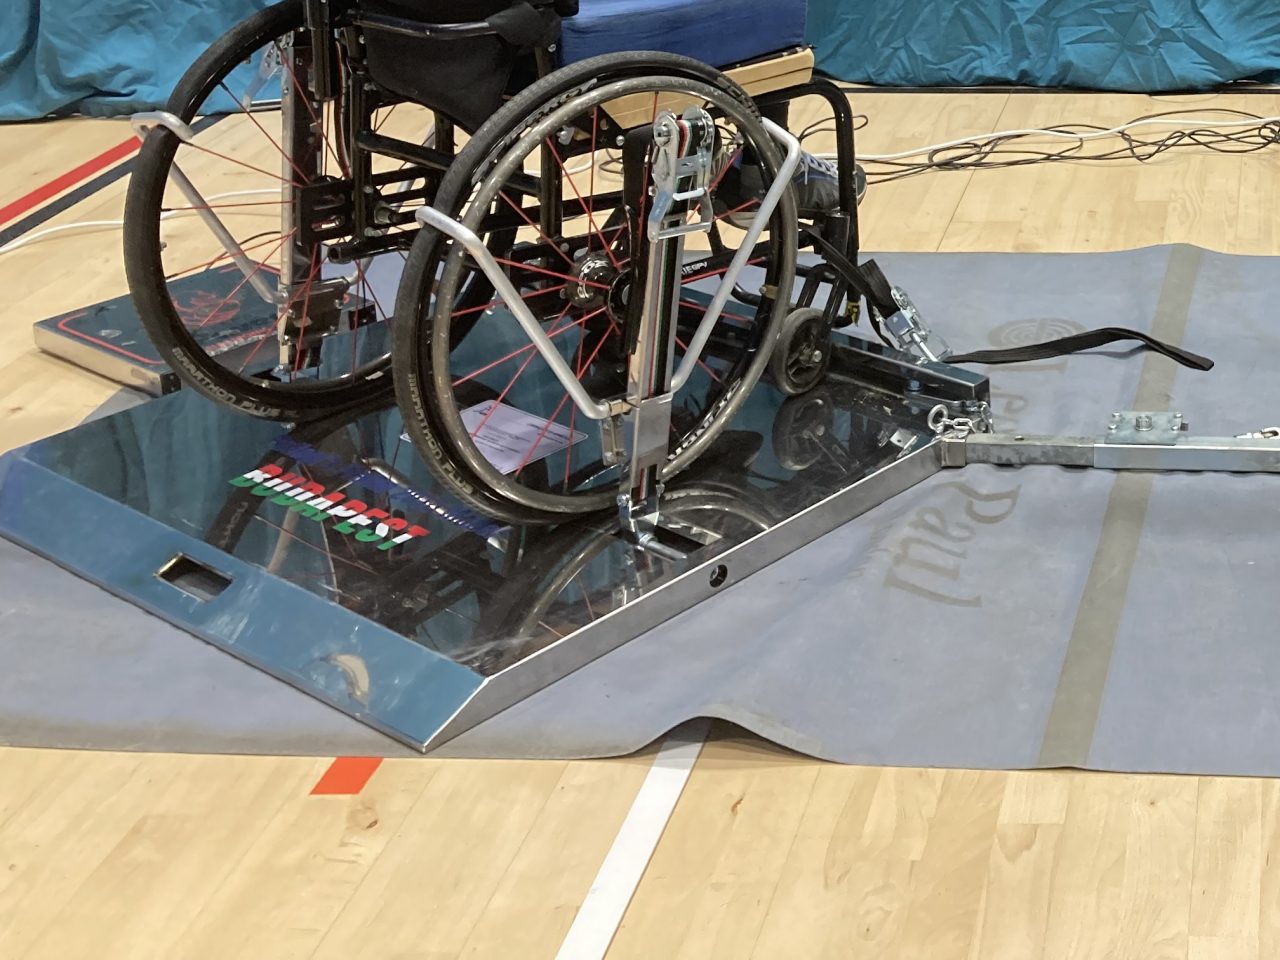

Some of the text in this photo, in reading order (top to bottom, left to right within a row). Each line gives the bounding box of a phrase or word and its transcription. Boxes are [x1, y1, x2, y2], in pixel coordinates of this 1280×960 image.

[172, 346, 281, 417] MARATHON PLUS
[408, 373, 474, 495] MARATHON PLUS
[228, 464, 431, 551] BUDAPEST
